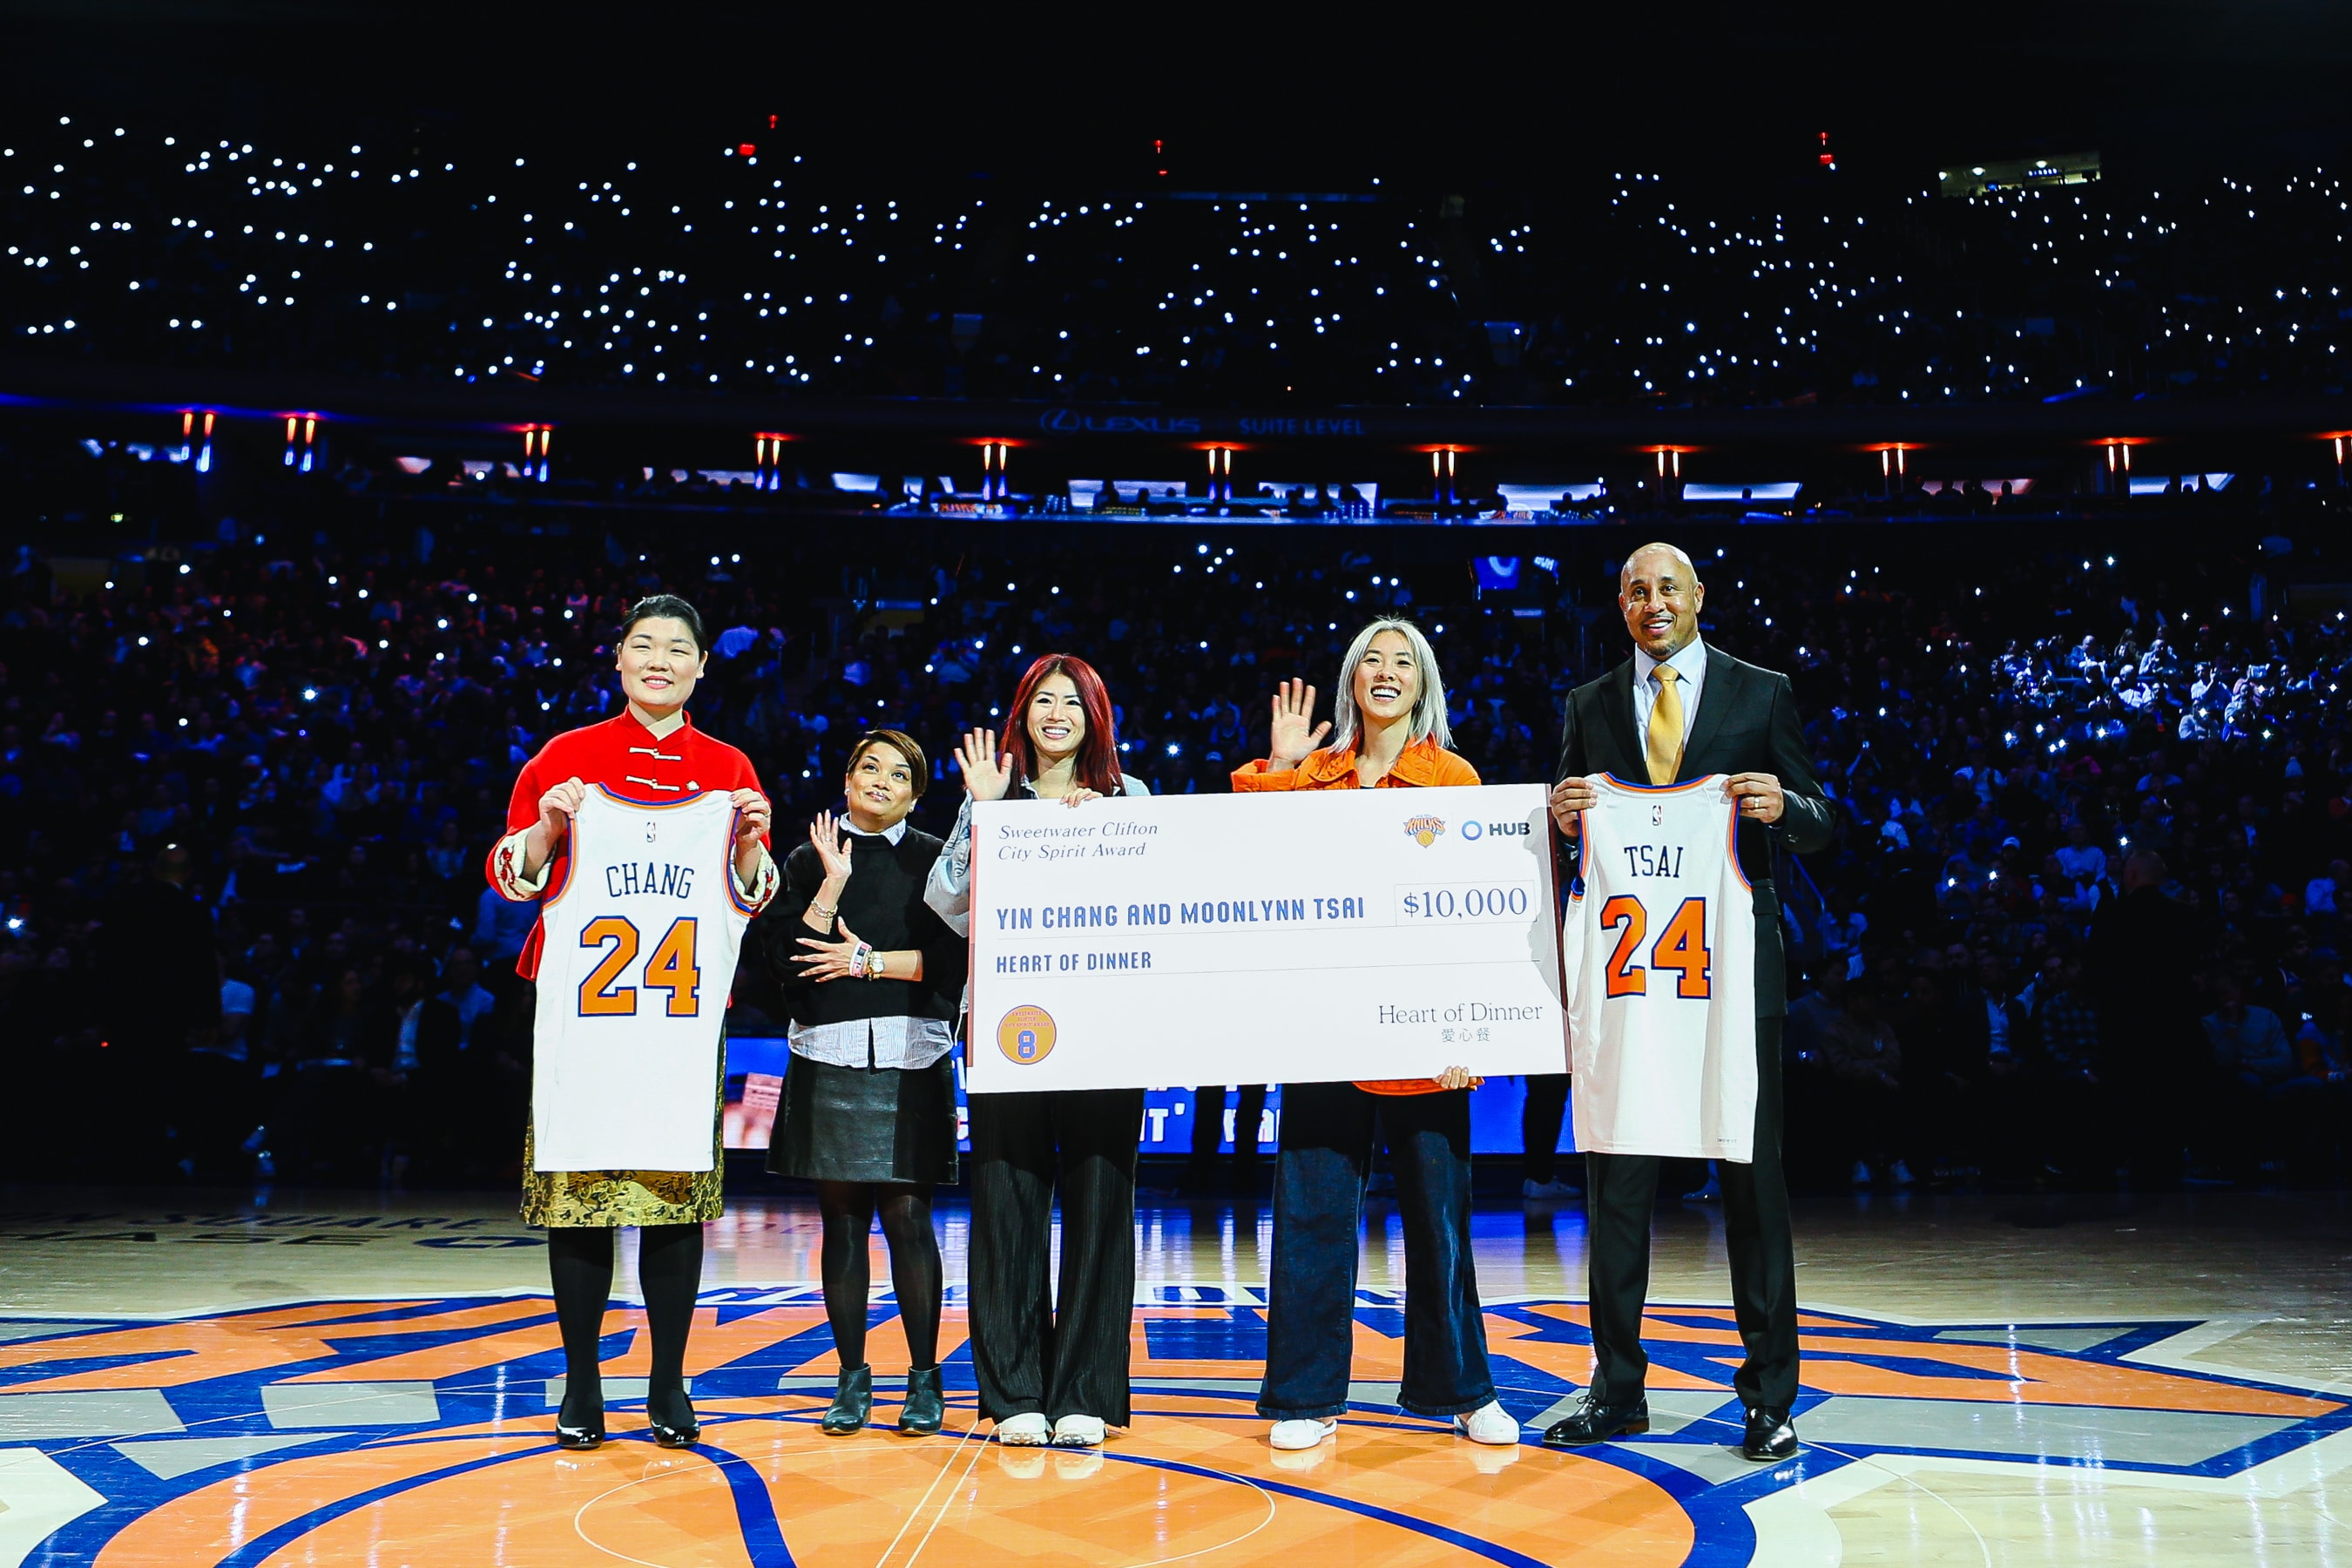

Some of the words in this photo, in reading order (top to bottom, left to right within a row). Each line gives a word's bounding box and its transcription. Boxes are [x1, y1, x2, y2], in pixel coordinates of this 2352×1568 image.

[1085, 416, 1201, 434] LEXUS
[1239, 417, 1296, 435] SUITE
[1304, 418, 1366, 435] LEVEL
[999, 826, 1096, 840] Sweetwater
[1102, 821, 1158, 836] Clifton
[1404, 816, 1446, 836] KNICKS
[1489, 821, 1531, 837] HUB
[998, 845, 1032, 862] City
[1037, 844, 1086, 862] Spirit
[1092, 842, 1146, 857] Award
[1623, 845, 1685, 879] TSAI
[605, 862, 695, 899] CHANG
[997, 907, 1032, 929] YIN
[1042, 905, 1118, 929] CHANG
[1127, 902, 1172, 926] AND
[1180, 899, 1305, 924] MOONLYNN
[1313, 896, 1364, 920] TSAI
[1403, 888, 1528, 920] $10,000
[1599, 894, 1712, 1000] 24
[578, 915, 701, 1017] 24
[997, 954, 1052, 973] HEART
[1059, 954, 1079, 971] OF
[1087, 951, 1152, 970] DINNER
[1378, 1004, 1436, 1024] Heart
[1443, 1003, 1465, 1023] of
[1470, 1002, 1543, 1022] Dinner
[1017, 1029, 1037, 1060] 8
